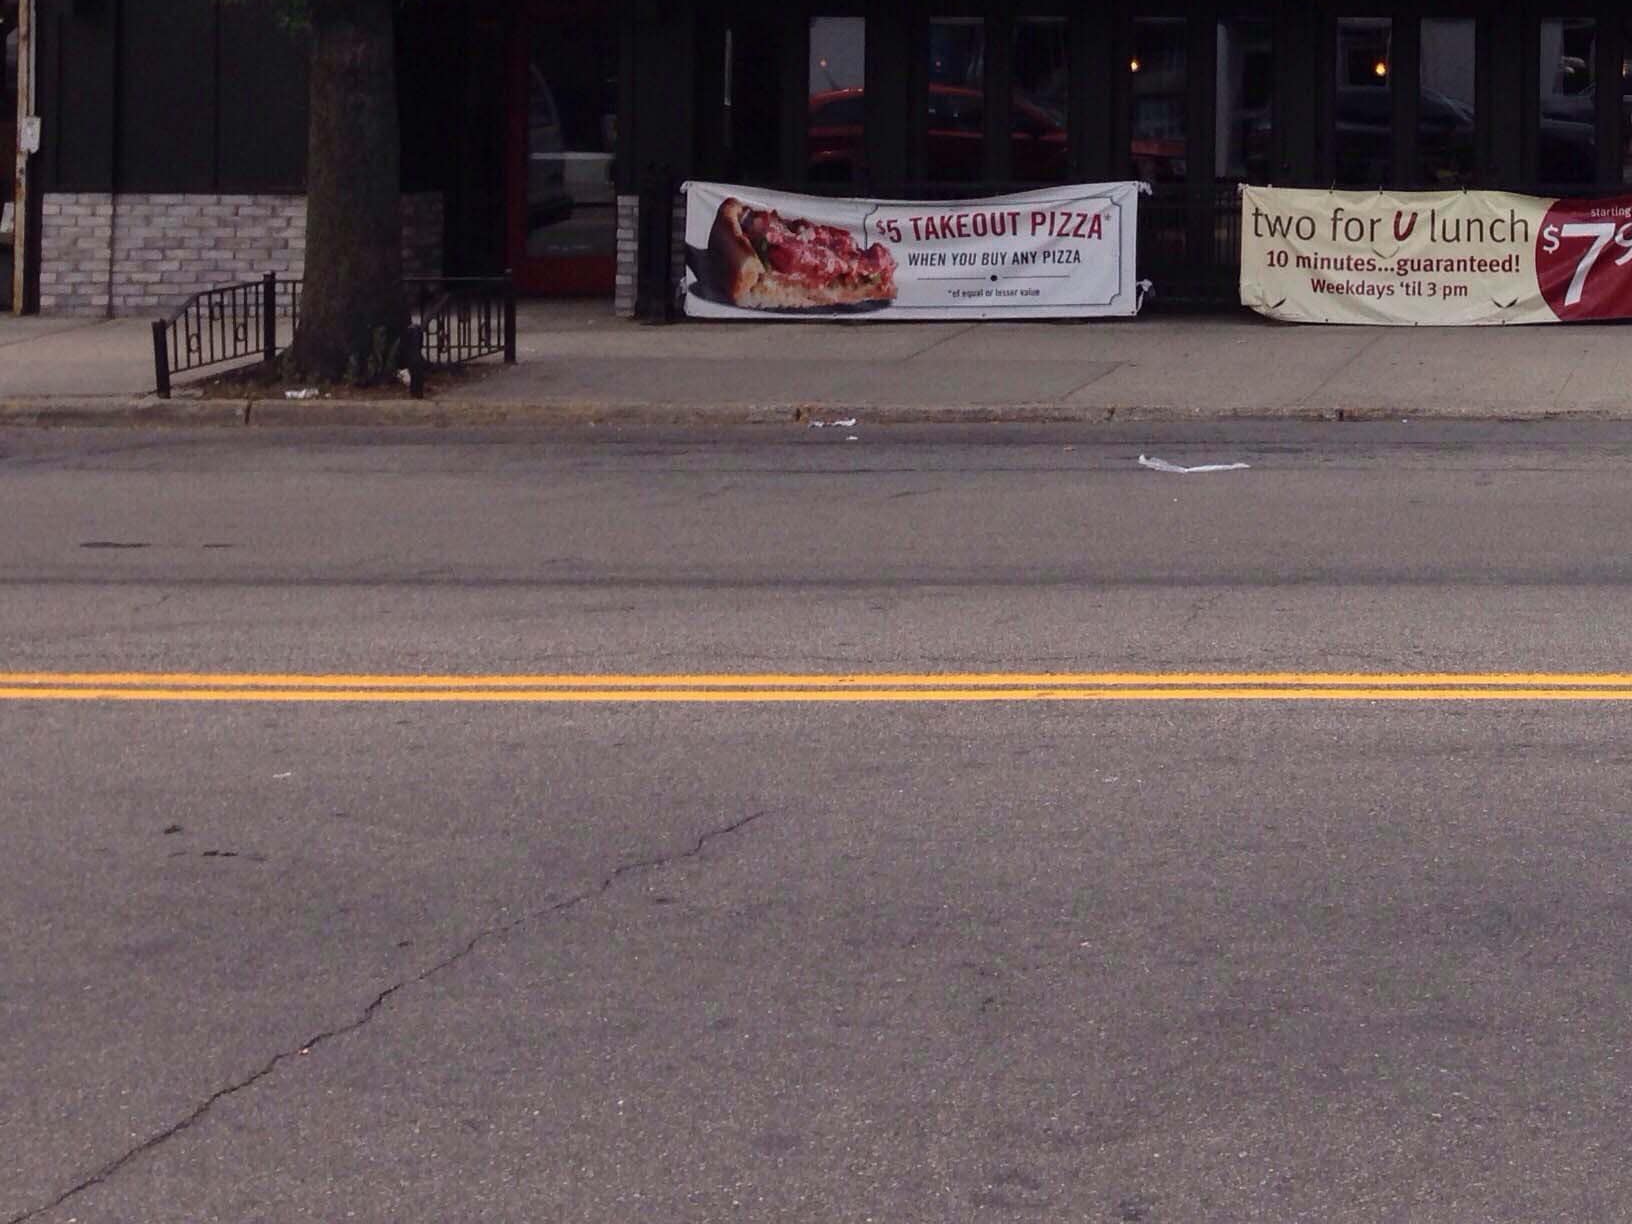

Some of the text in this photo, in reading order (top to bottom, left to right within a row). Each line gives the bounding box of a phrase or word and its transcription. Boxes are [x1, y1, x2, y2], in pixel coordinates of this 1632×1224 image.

[1591, 206, 1631, 217] starting
[875, 221, 902, 244] $5
[909, 212, 1020, 242] TAKEOUT
[1252, 210, 1316, 241] two
[1331, 207, 1382, 243] for
[1429, 210, 1530, 243] lunch
[907, 250, 1081, 267] WHEN YOU BUY ANY PIZZA
[1266, 250, 1288, 268] 10
[1311, 279, 1395, 298] Weekdays
[1427, 283, 1438, 297] 3
[1442, 283, 1468, 300] pm
